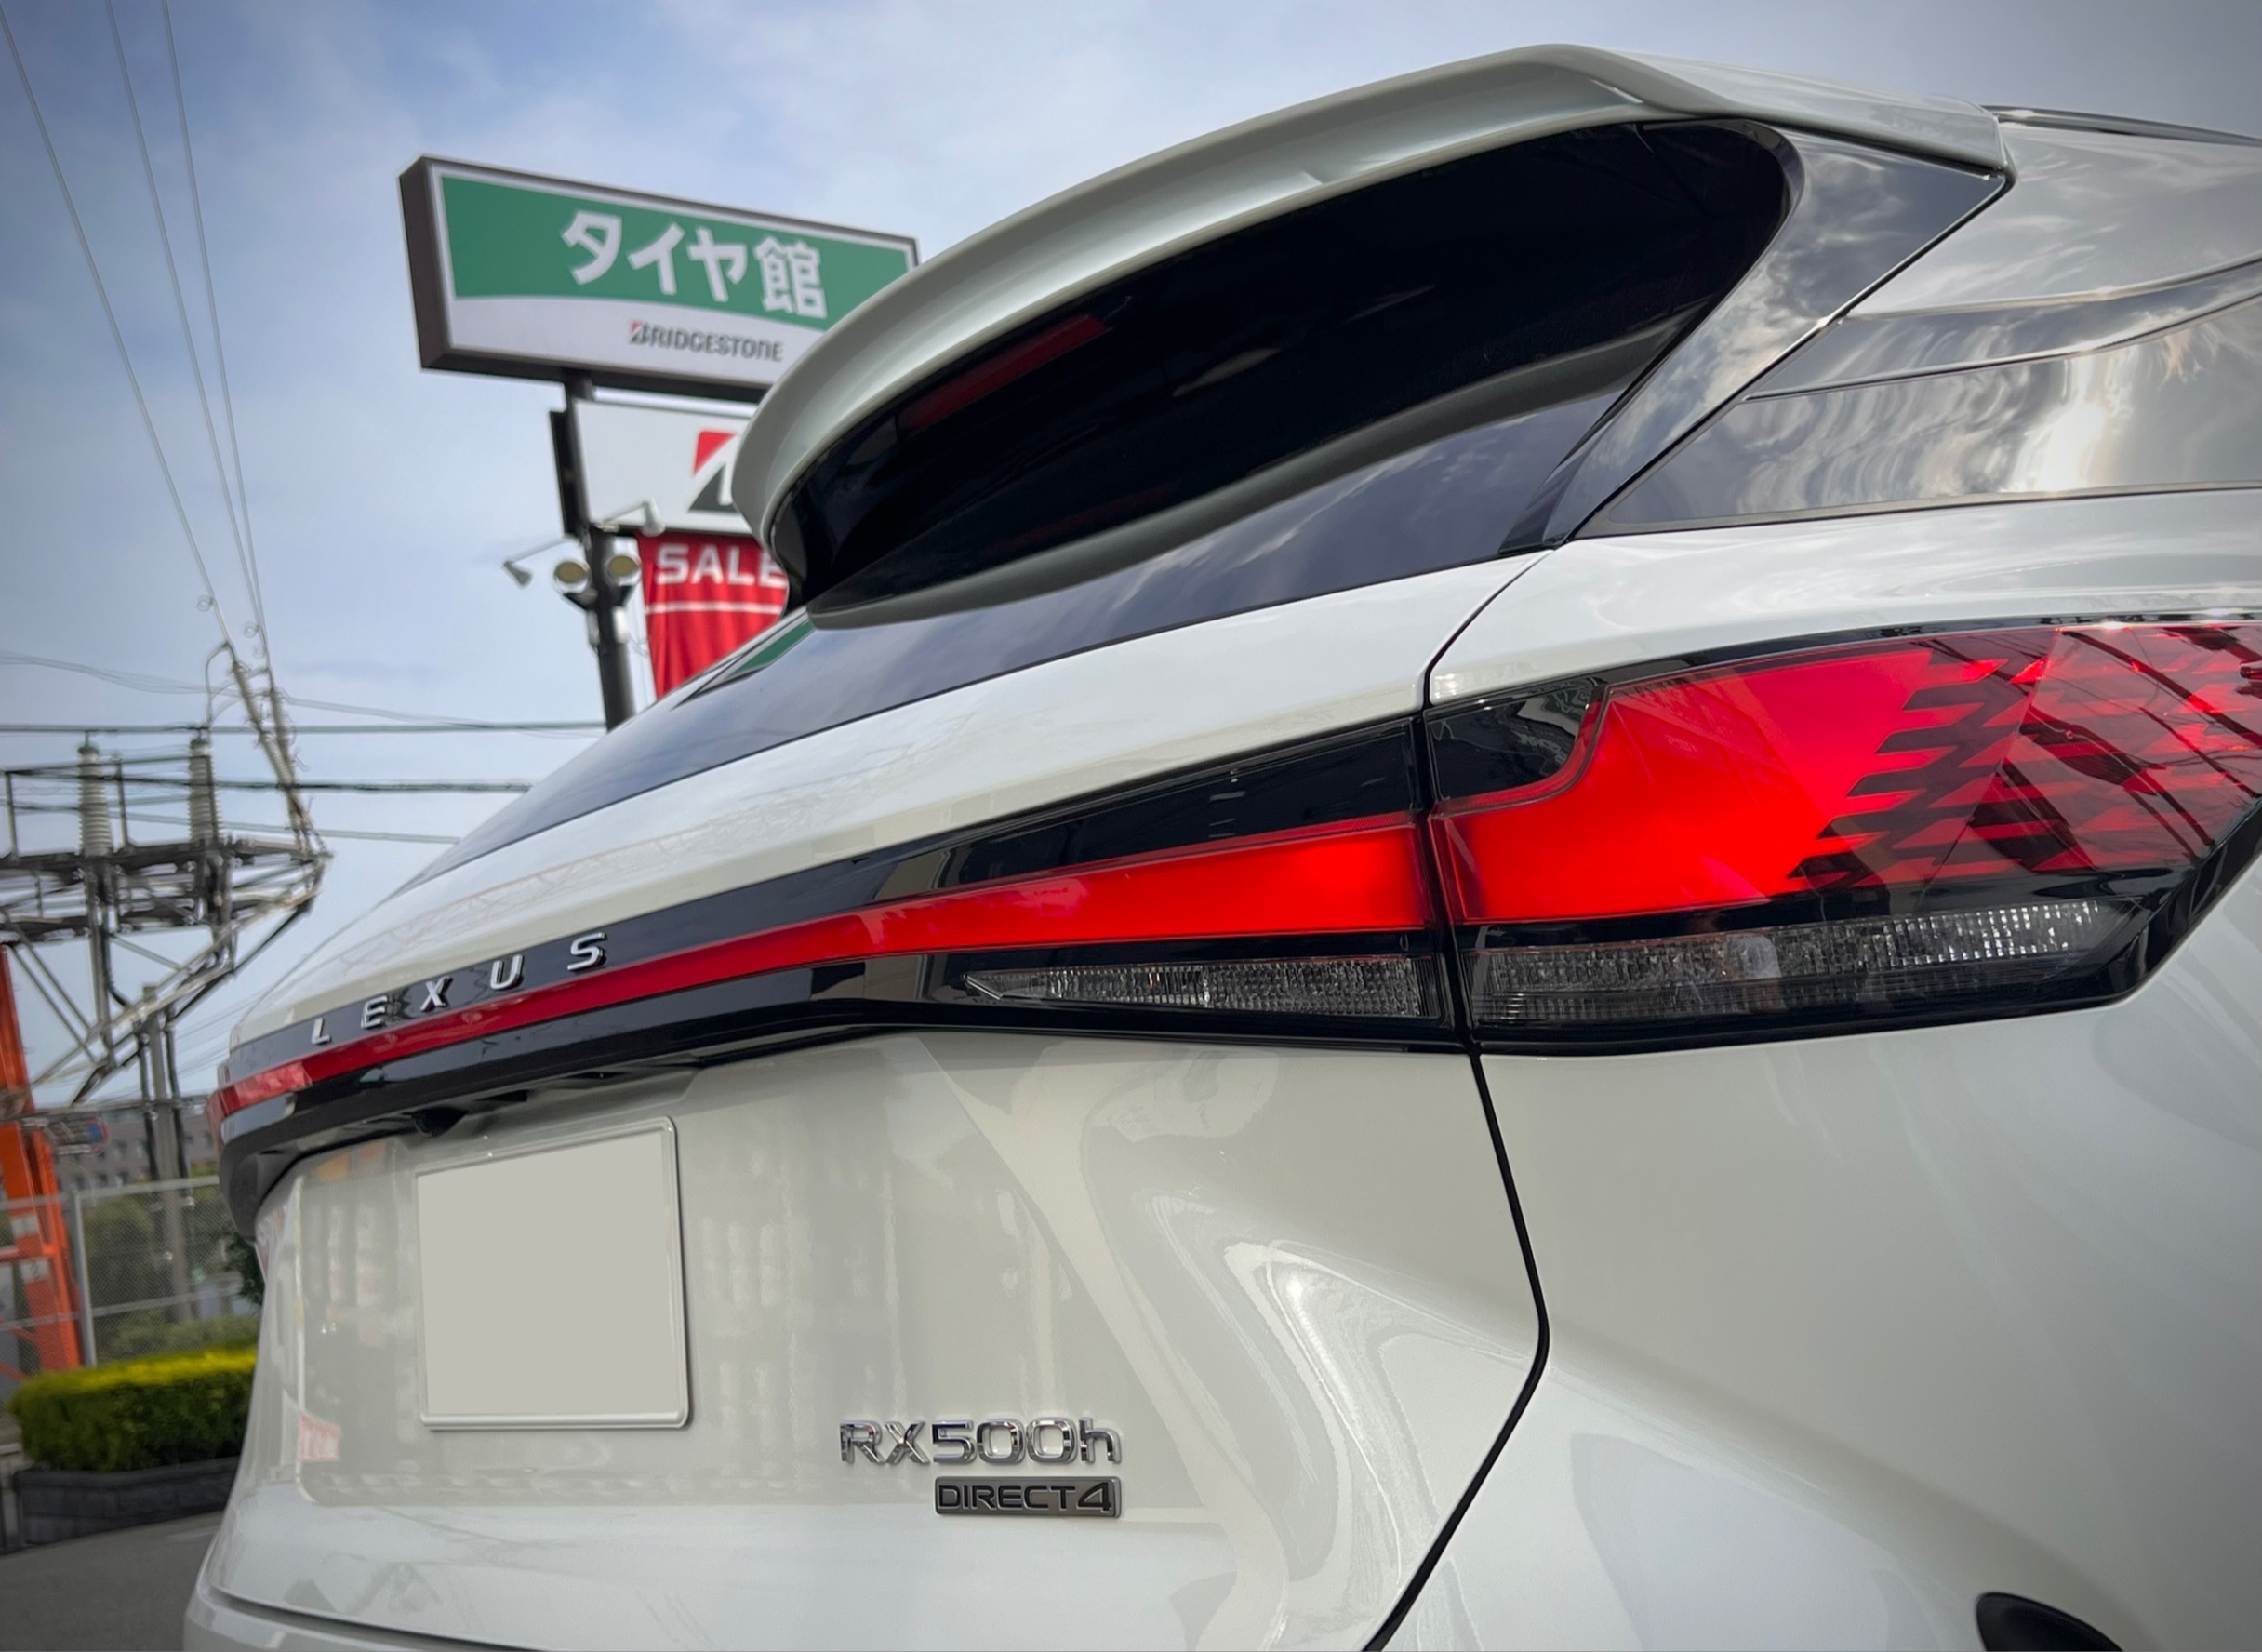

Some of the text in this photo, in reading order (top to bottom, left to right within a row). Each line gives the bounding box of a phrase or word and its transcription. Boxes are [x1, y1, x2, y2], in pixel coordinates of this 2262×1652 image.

[561, 209, 828, 320] タイヤ館
[630, 320, 784, 363] BRIDGESTONE
[656, 542, 788, 590] SALE
[311, 931, 609, 1046] LEXUS
[839, 1417, 1123, 1465] RX500h
[937, 1482, 1114, 1514] DIRECT4
